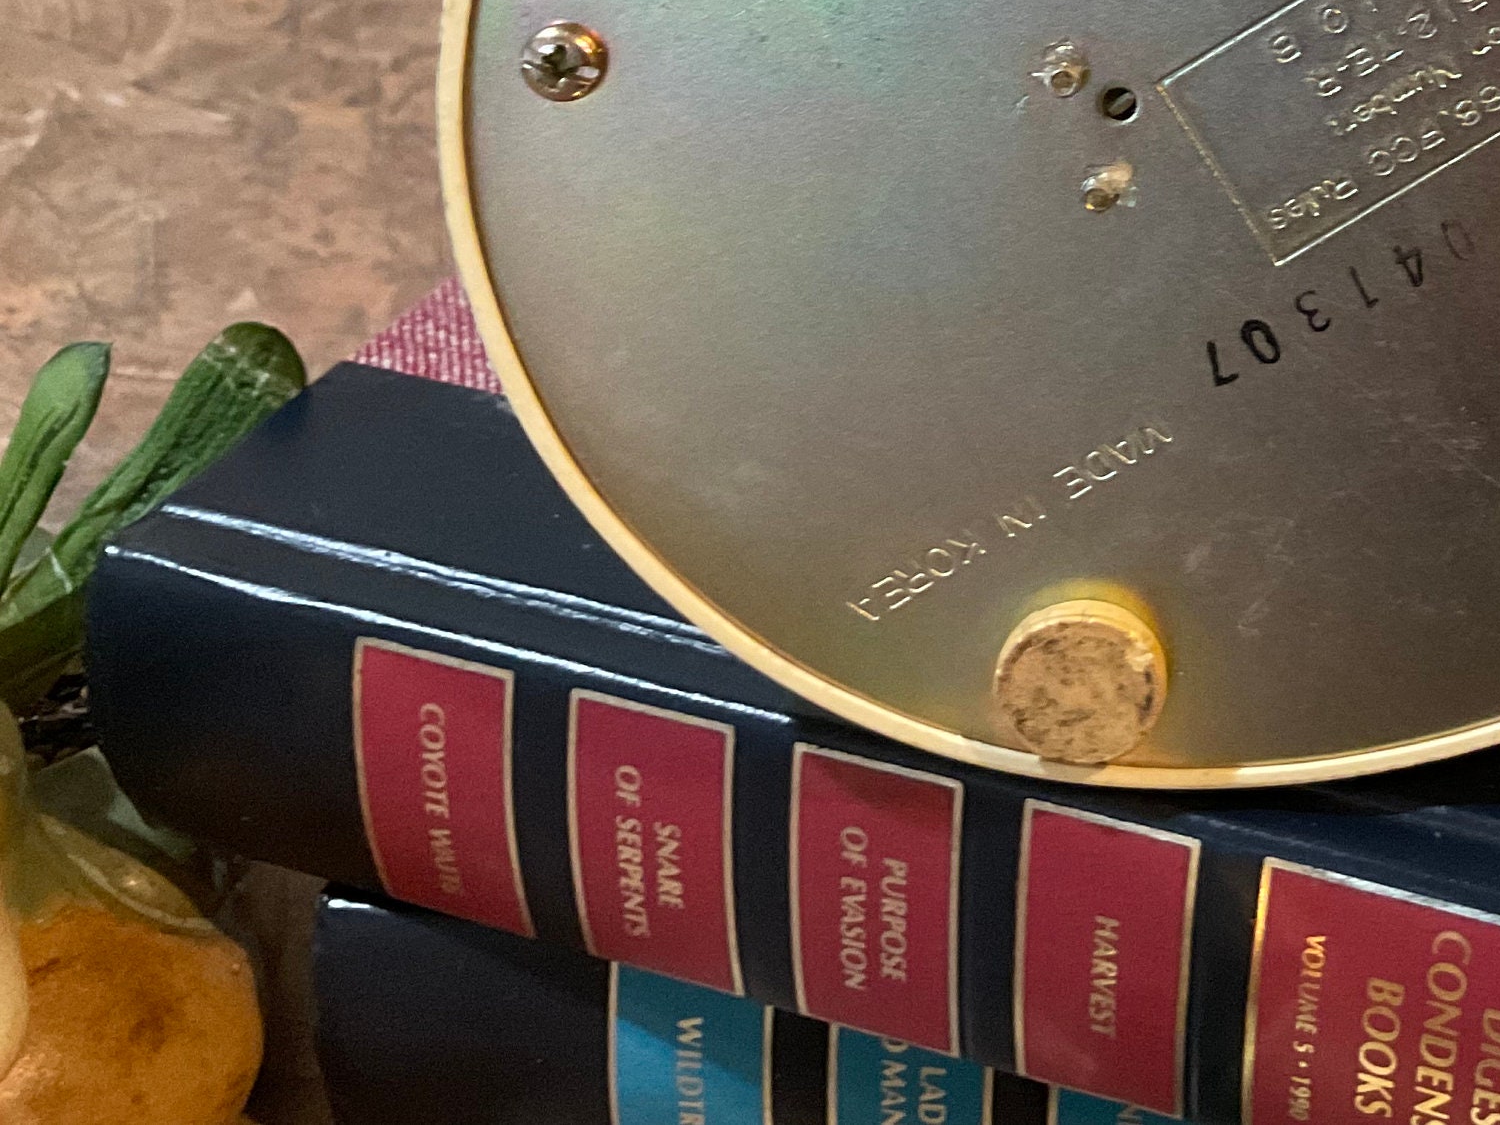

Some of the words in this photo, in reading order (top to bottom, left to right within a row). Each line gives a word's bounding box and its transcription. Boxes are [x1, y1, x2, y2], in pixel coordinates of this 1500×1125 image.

[1268, 178, 1359, 230] Rules
[1052, 425, 1174, 500] MADE
[992, 494, 1047, 538] IN
[845, 528, 987, 621] KOREA
[418, 702, 450, 818] COYOTE
[614, 764, 643, 807] OF
[615, 816, 649, 939] SERPENTS
[652, 821, 685, 910] SNARE
[839, 826, 868, 868] OF
[838, 878, 868, 991] EVASION
[879, 858, 908, 983] PURPOSE
[1088, 915, 1121, 1039] HARVEST
[1295, 935, 1327, 1035] VOLUME
[1354, 977, 1405, 1119] BOOKS
